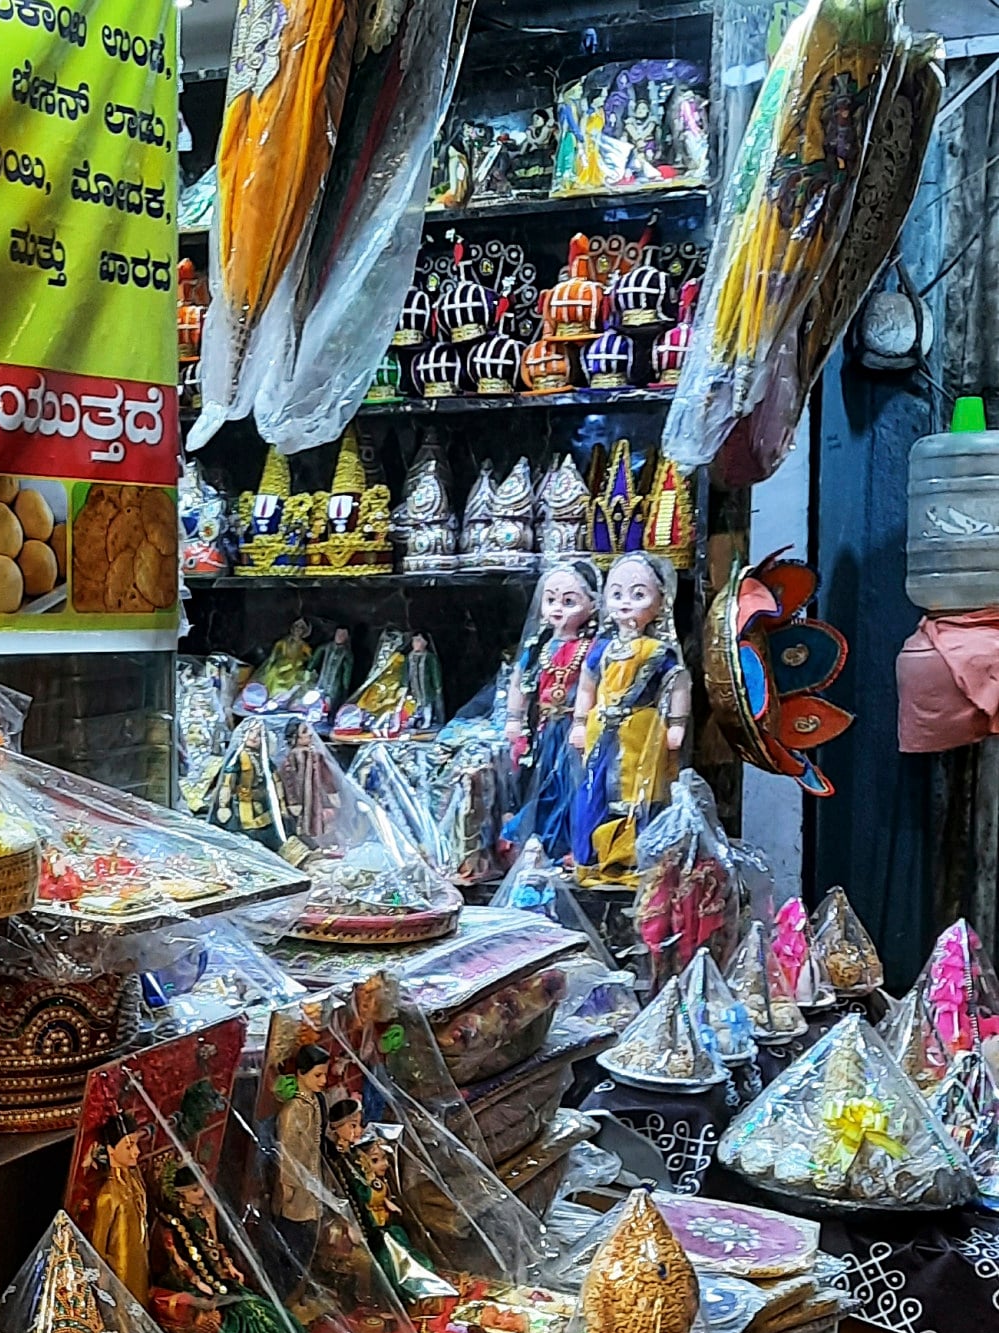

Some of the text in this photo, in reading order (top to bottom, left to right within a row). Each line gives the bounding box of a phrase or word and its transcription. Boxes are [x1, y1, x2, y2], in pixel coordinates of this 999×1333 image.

[104, 102, 171, 152] ಲಾಡು,
[70, 159, 171, 225] ಮೋದಕ,
[10, 222, 67, 287] ಮತ್ತು
